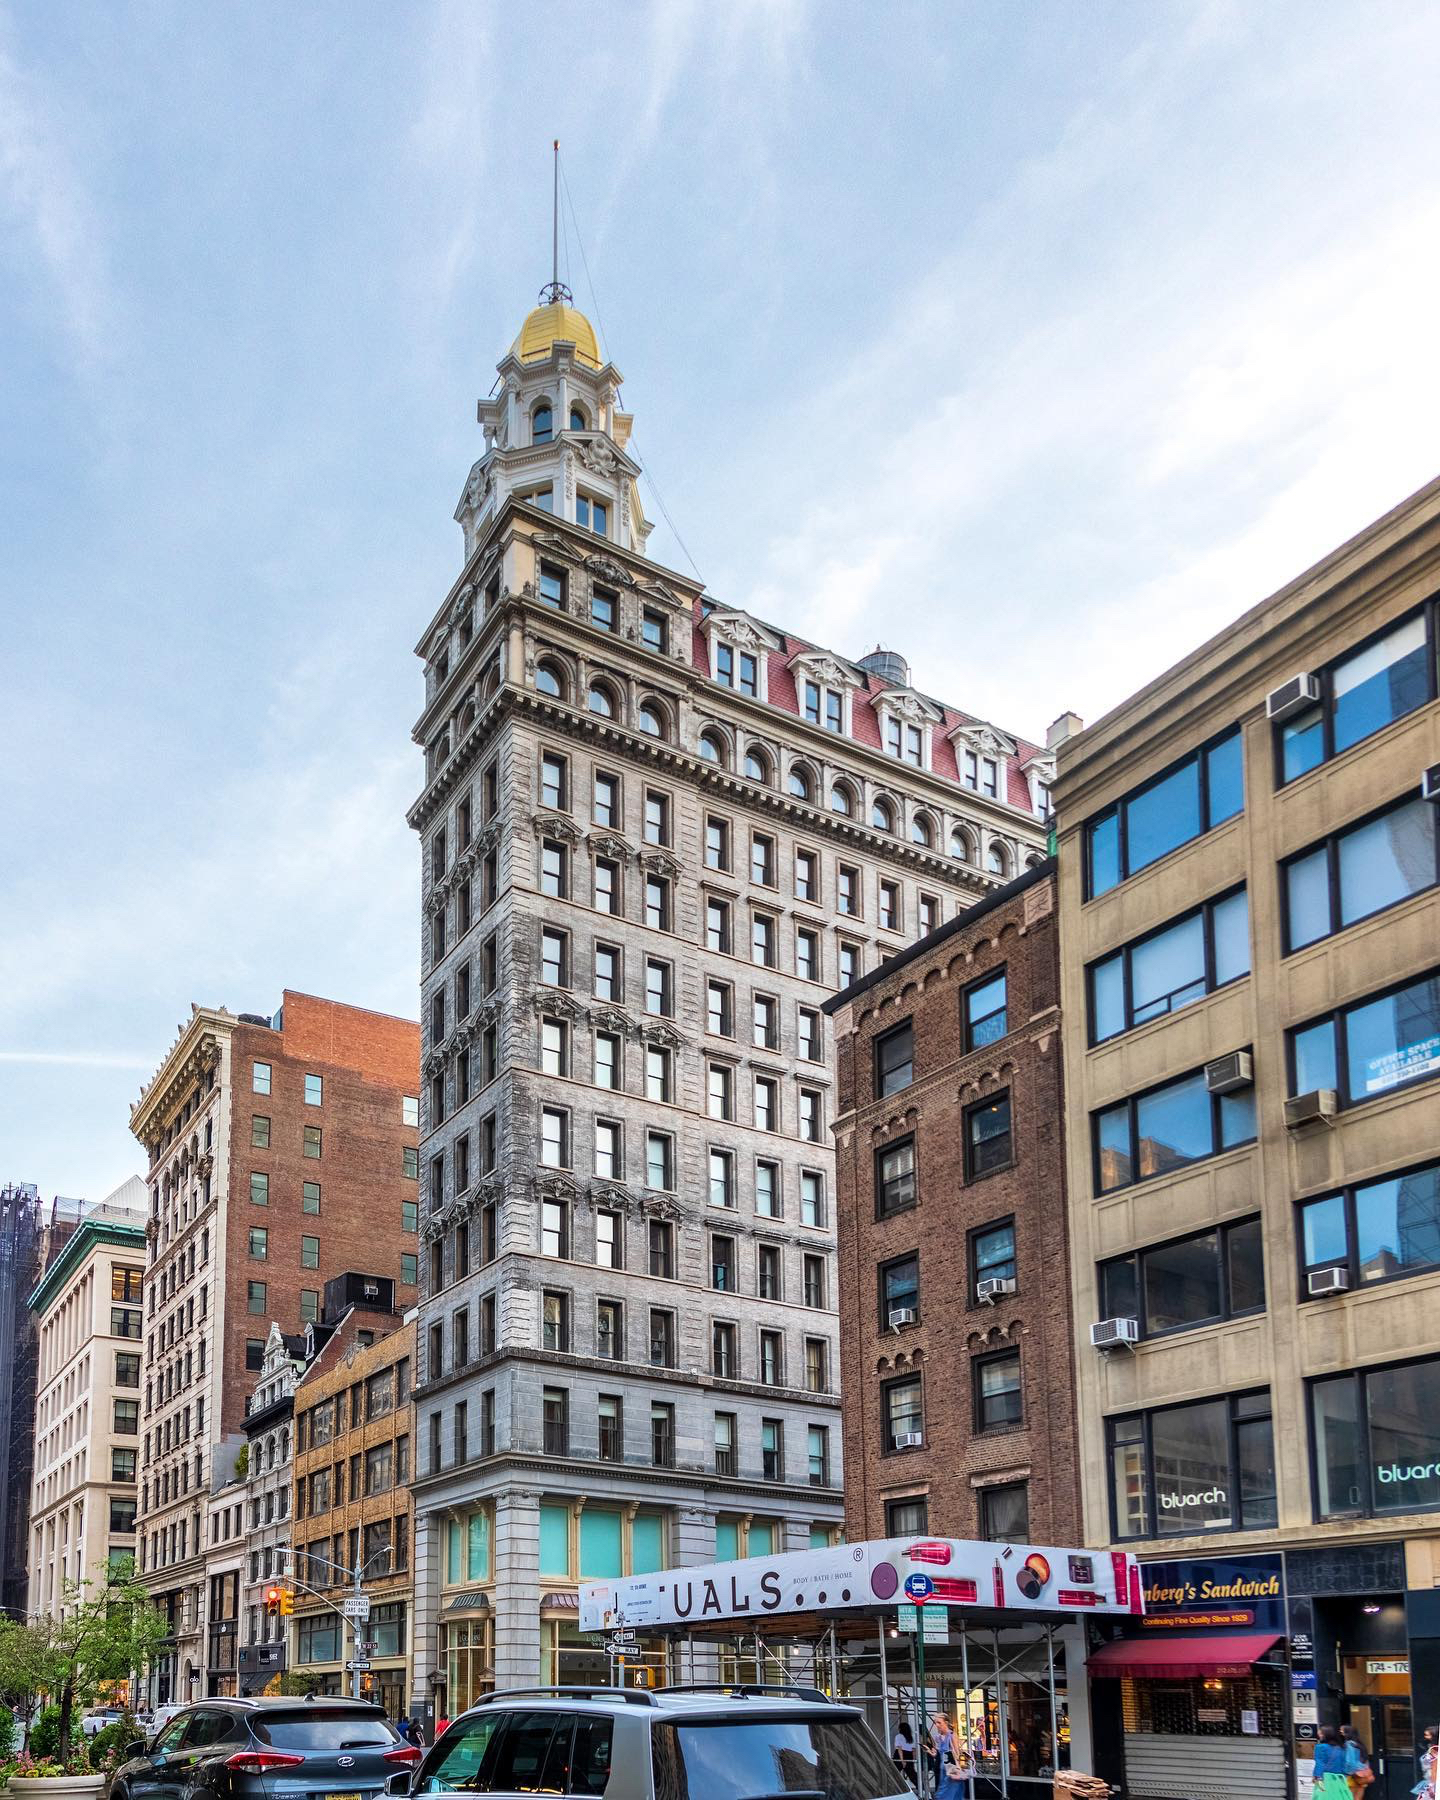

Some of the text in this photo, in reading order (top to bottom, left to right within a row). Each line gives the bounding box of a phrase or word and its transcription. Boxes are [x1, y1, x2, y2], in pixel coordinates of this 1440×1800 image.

[1161, 1487, 1226, 1509] bluarch
[793, 1576, 808, 1585] BODY
[814, 1574, 830, 1582] BATH
[835, 1571, 852, 1581] HOME
[1200, 1575, 1280, 1599] Sandwich
[1142, 1617, 1174, 1627] Continuing
[1175, 1617, 1188, 1625] Fine
[1189, 1616, 1210, 1626] Quality
[1211, 1615, 1230, 1623] Since
